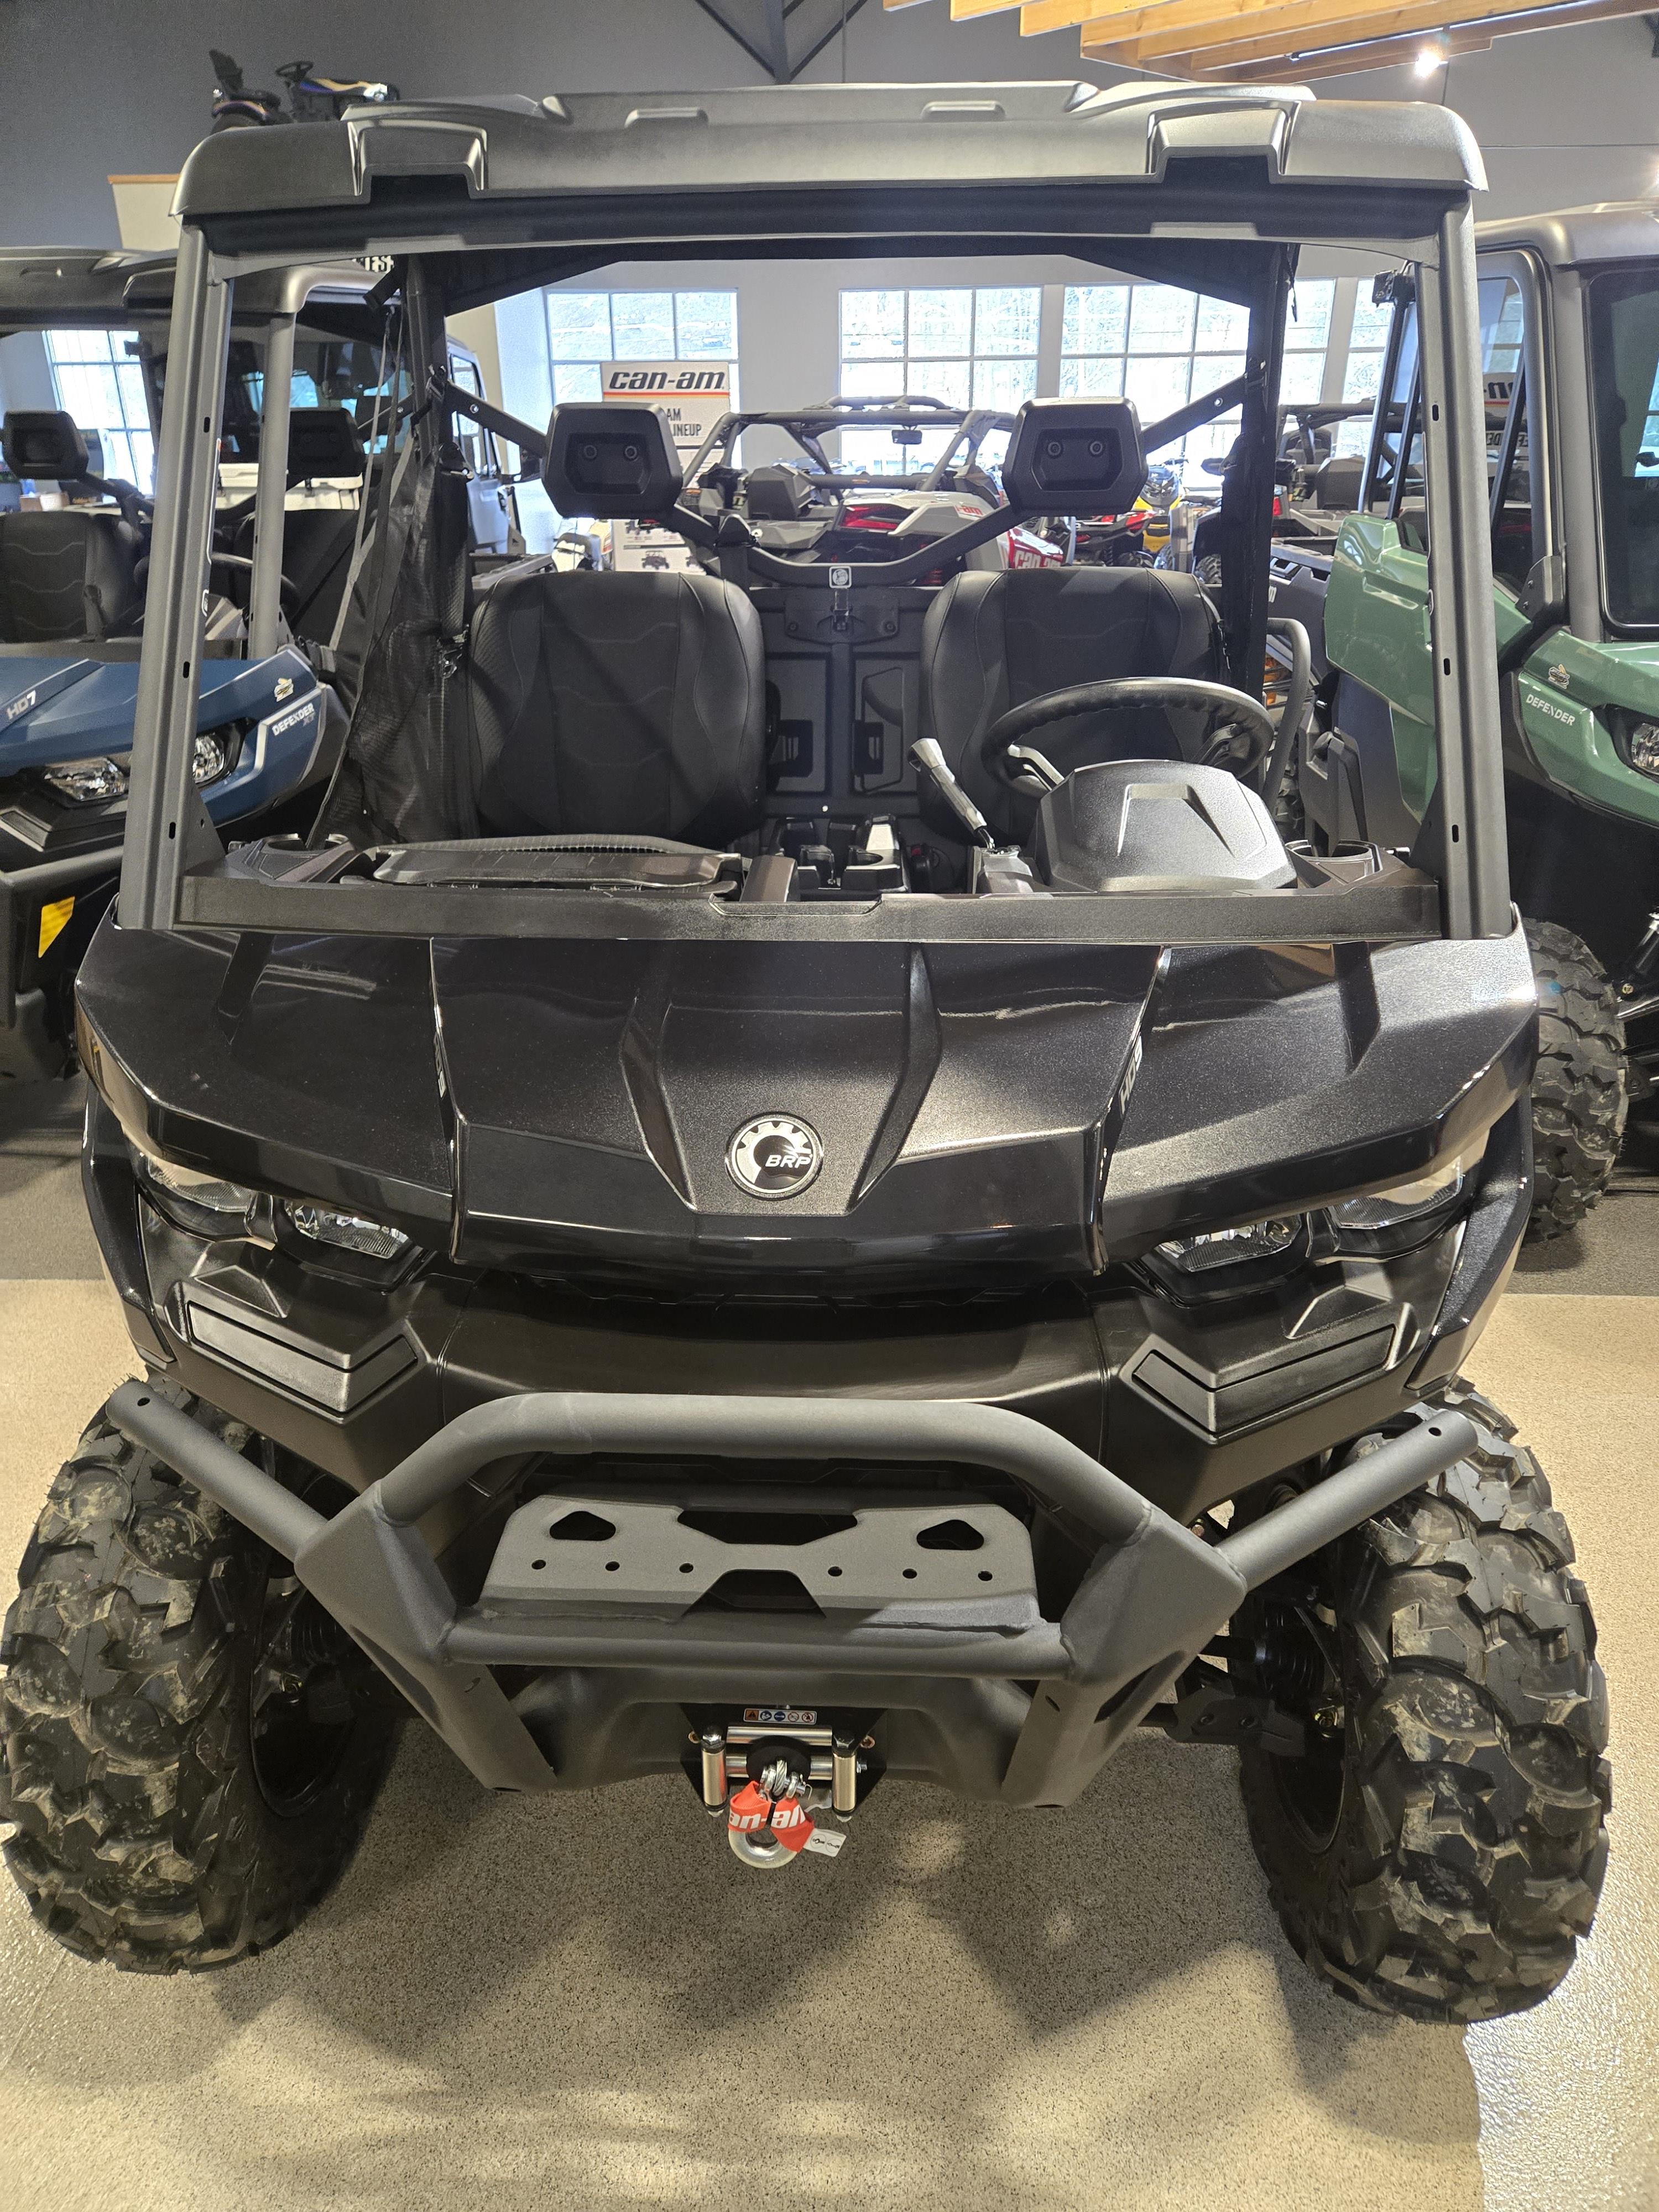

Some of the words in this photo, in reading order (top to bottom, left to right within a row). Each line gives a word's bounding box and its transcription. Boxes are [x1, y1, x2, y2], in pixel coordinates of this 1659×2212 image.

[609, 372, 725, 389] can-am
[672, 424, 701, 436] INEUP
[7, 690, 36, 719] HD7
[1526, 693, 1575, 726] DEFENDER
[272, 702, 315, 736] DEFENDER
[765, 1154, 812, 1169] BRP
